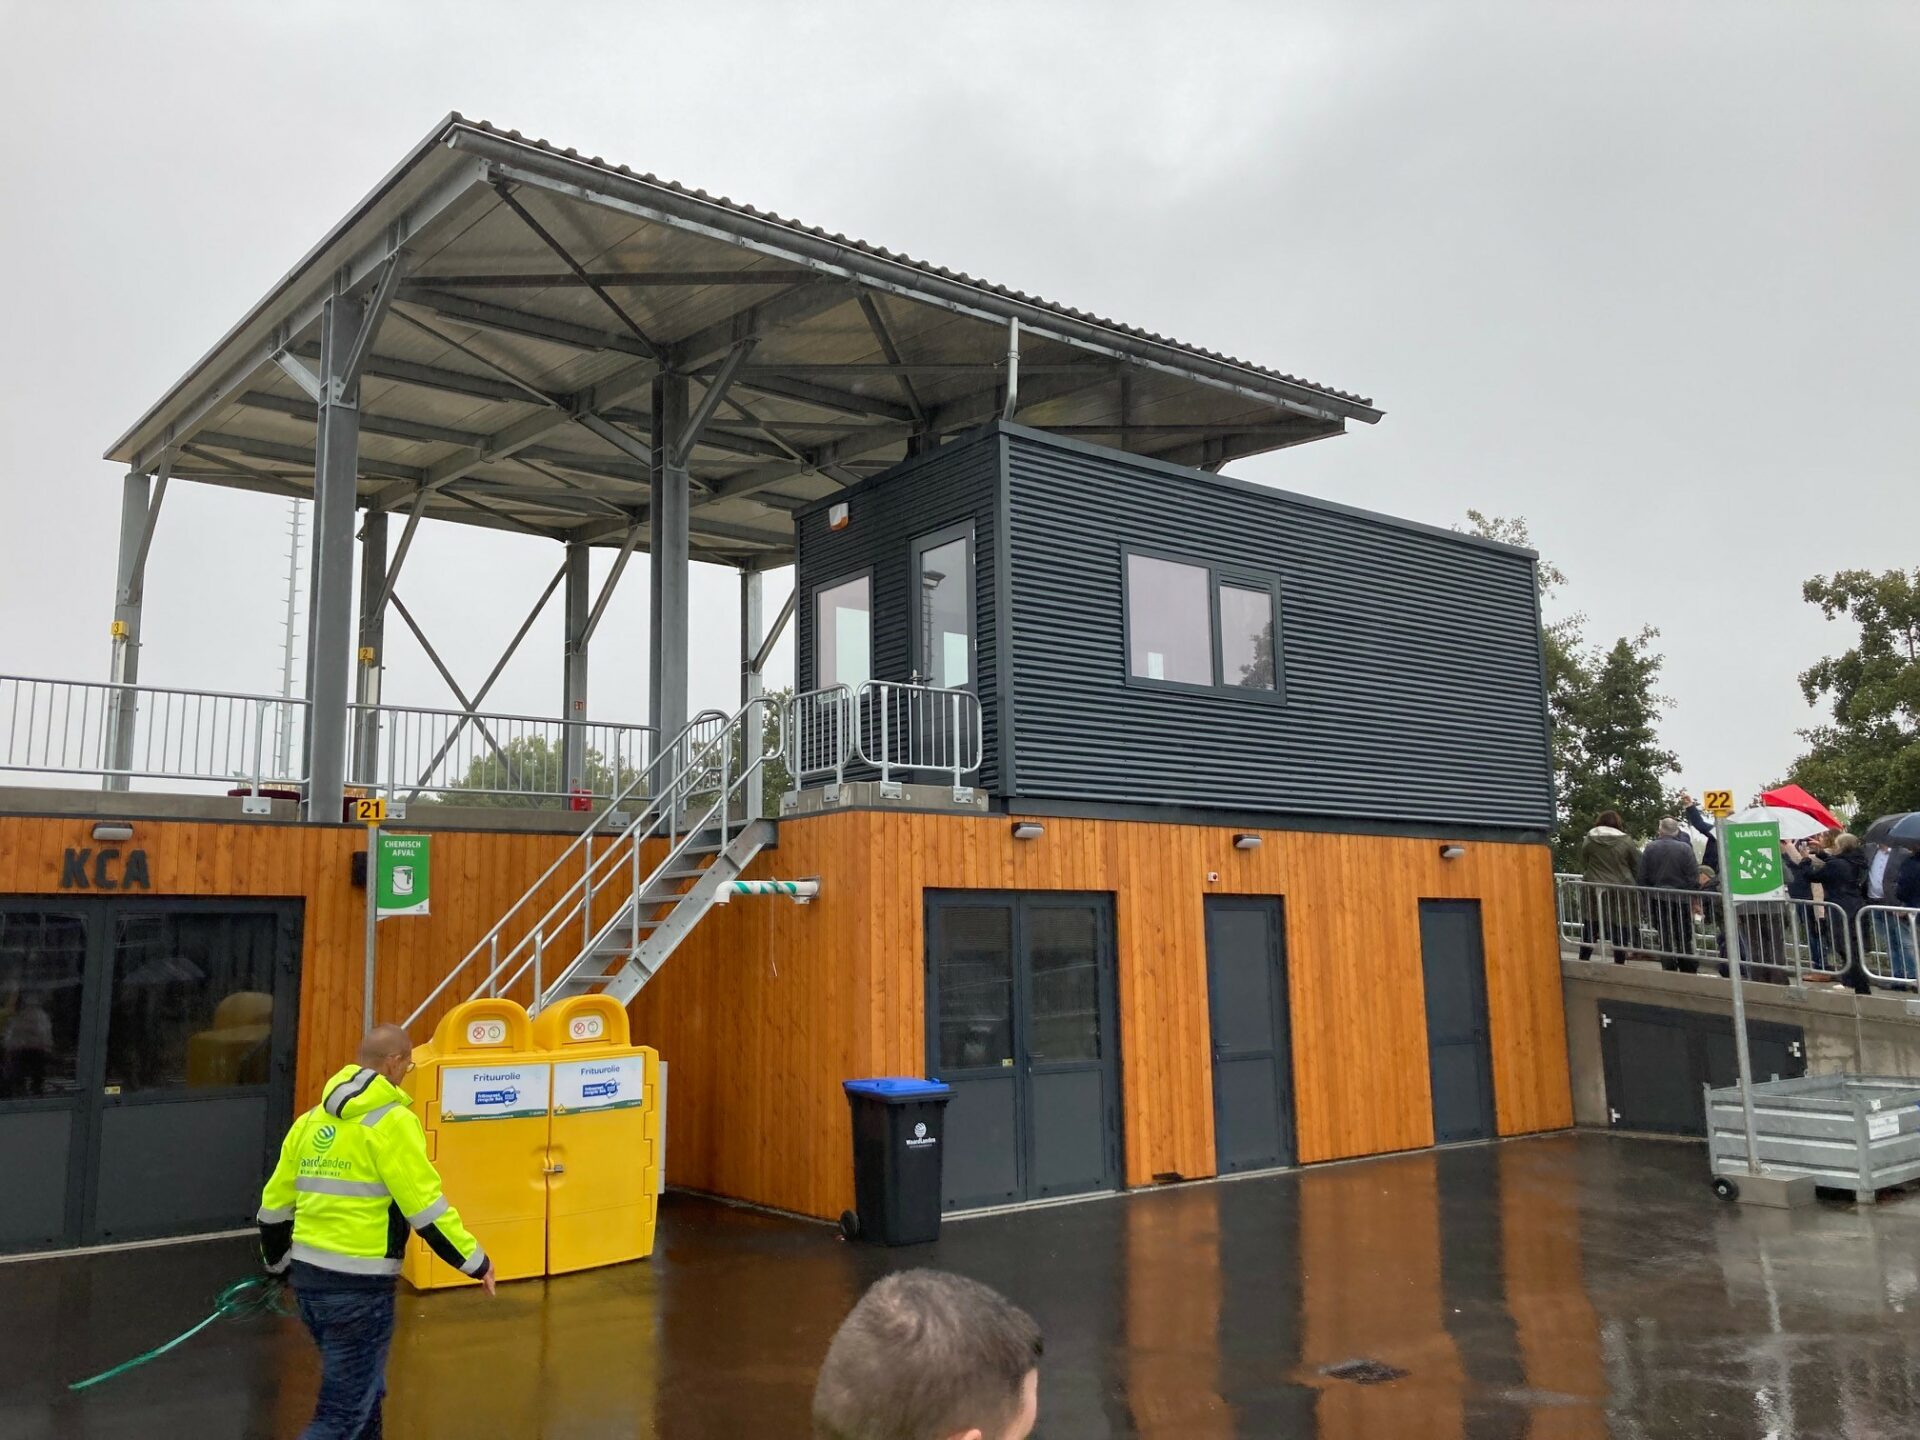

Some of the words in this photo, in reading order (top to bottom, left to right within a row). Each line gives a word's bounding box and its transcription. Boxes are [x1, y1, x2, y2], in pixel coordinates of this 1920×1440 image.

[1707, 792, 1731, 809] 22
[360, 801, 380, 818] 21
[384, 840, 421, 848] CHEMISCH
[392, 849, 415, 857] AFVAL
[63, 848, 151, 889] KCA
[580, 1064, 621, 1076] Frituurolie
[473, 1072, 521, 1082] Frituurolie
